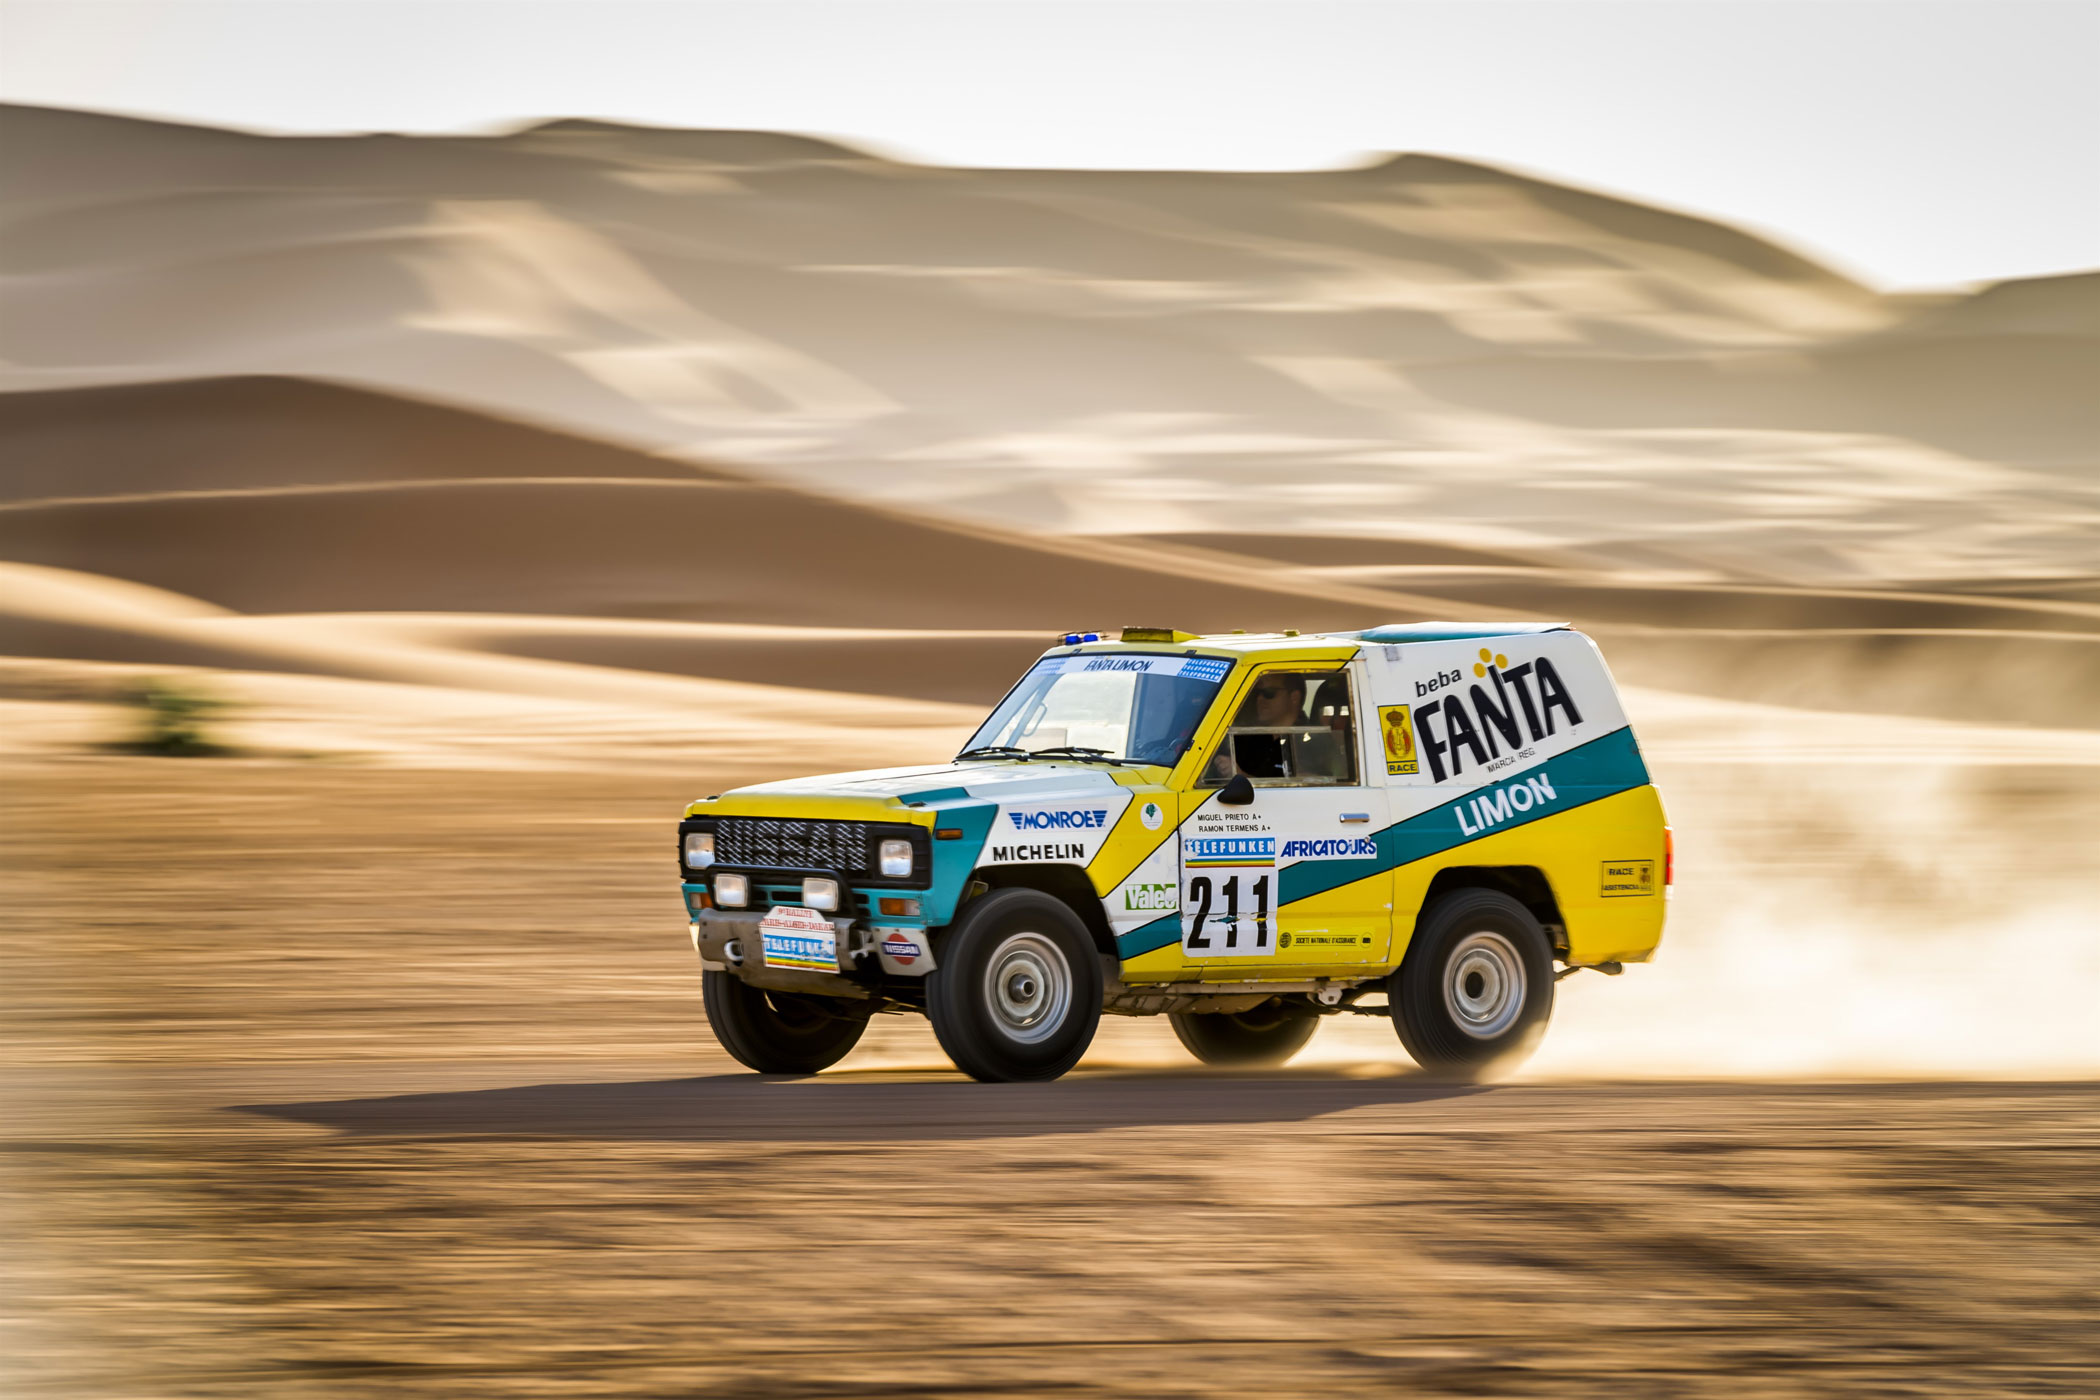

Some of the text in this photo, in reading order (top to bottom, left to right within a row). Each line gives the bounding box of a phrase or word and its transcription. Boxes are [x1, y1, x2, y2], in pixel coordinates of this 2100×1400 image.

[1112, 660, 1154, 672] LIMON
[1415, 669, 1463, 698] beba
[1413, 656, 1585, 785] FANTA
[1388, 763, 1417, 773] RACE
[1487, 755, 1516, 773] MARCA
[1454, 773, 1558, 837] LIMON
[1023, 810, 1096, 830] MONROE
[1197, 813, 1224, 822] MIGUEL
[1224, 813, 1250, 821] PRIETO
[1198, 825, 1224, 833] RAMON
[715, 819, 867, 871] NISSAN
[992, 843, 1085, 862] MICHELIN
[1185, 839, 1275, 855] TELEFUNKEN
[1280, 838, 1377, 858] AFRICATOURS
[1608, 867, 1634, 876] RACE
[1187, 875, 1269, 949] 211
